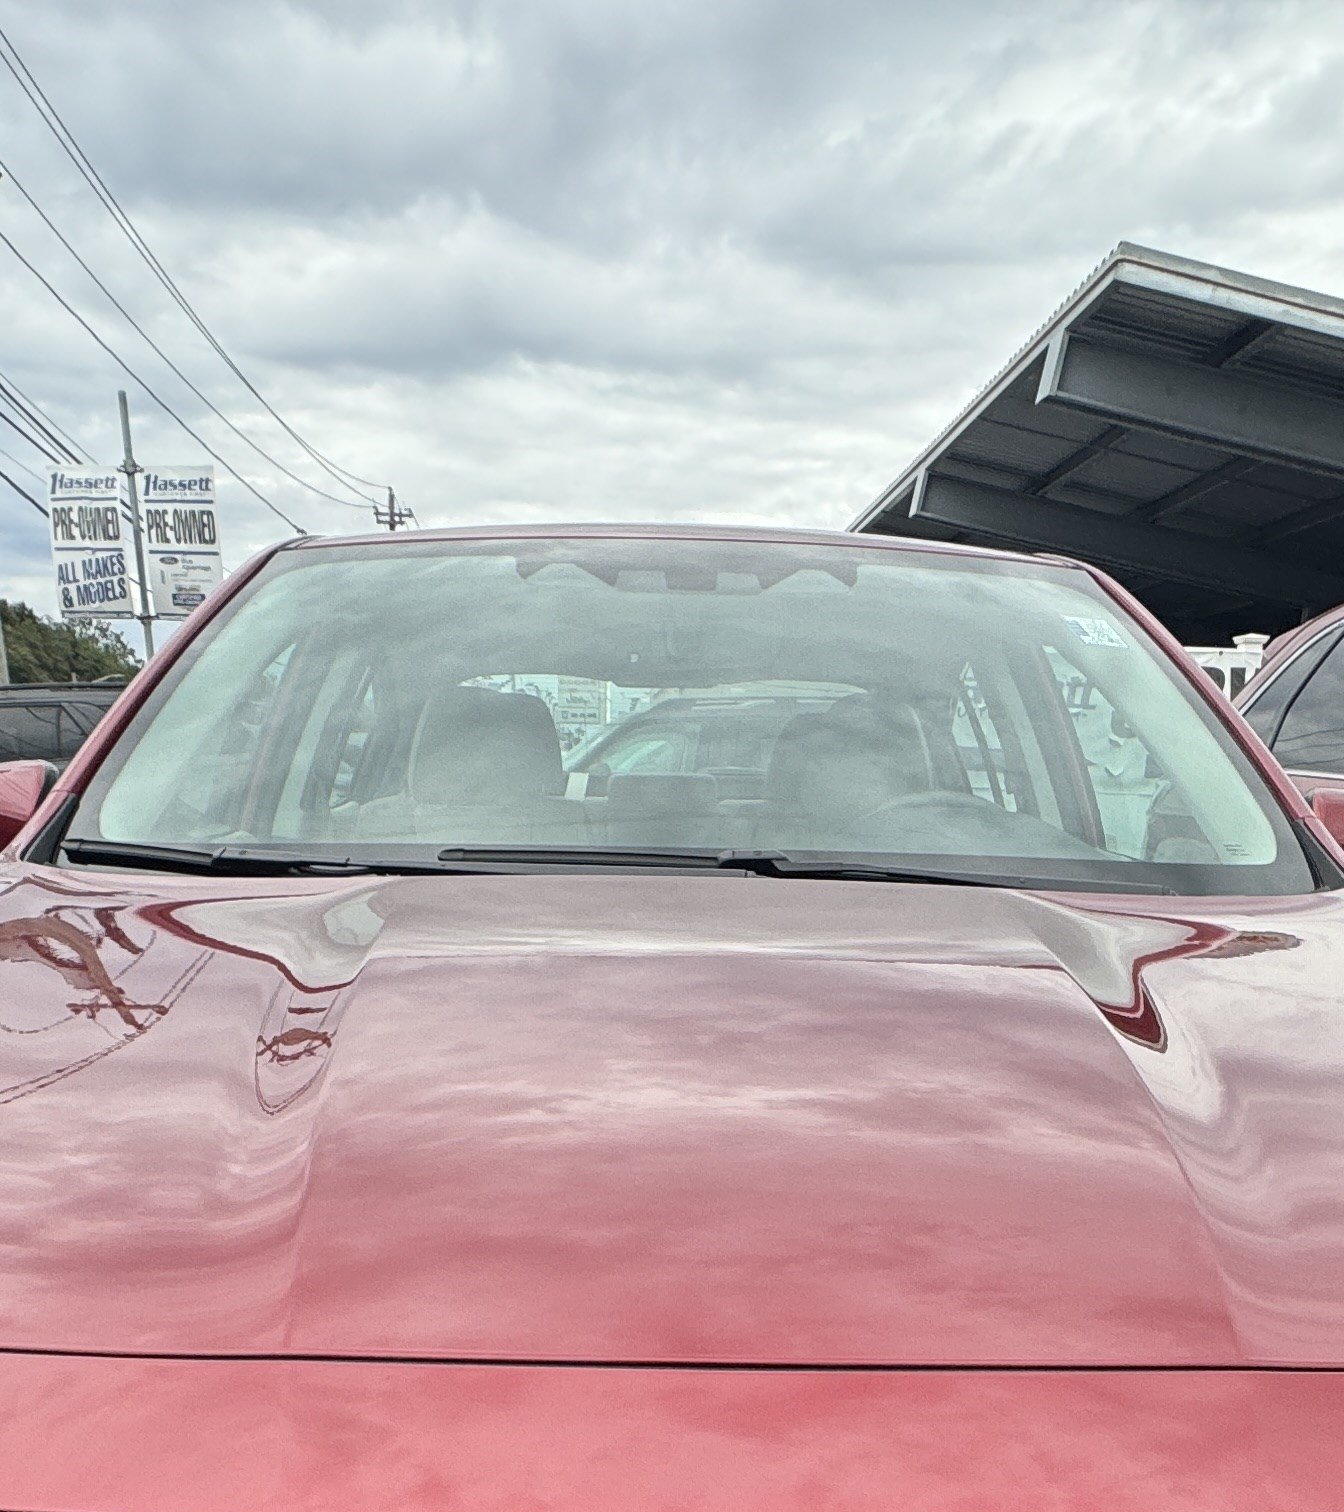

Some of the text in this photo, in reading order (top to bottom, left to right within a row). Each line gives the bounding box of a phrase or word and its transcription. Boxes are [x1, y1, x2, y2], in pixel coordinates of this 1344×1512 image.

[52, 506, 120, 541] PRE-OWNED
[145, 508, 216, 545] PRE-OWNED
[58, 553, 126, 586] ALL MAKES
[61, 577, 127, 609] & MODELS
